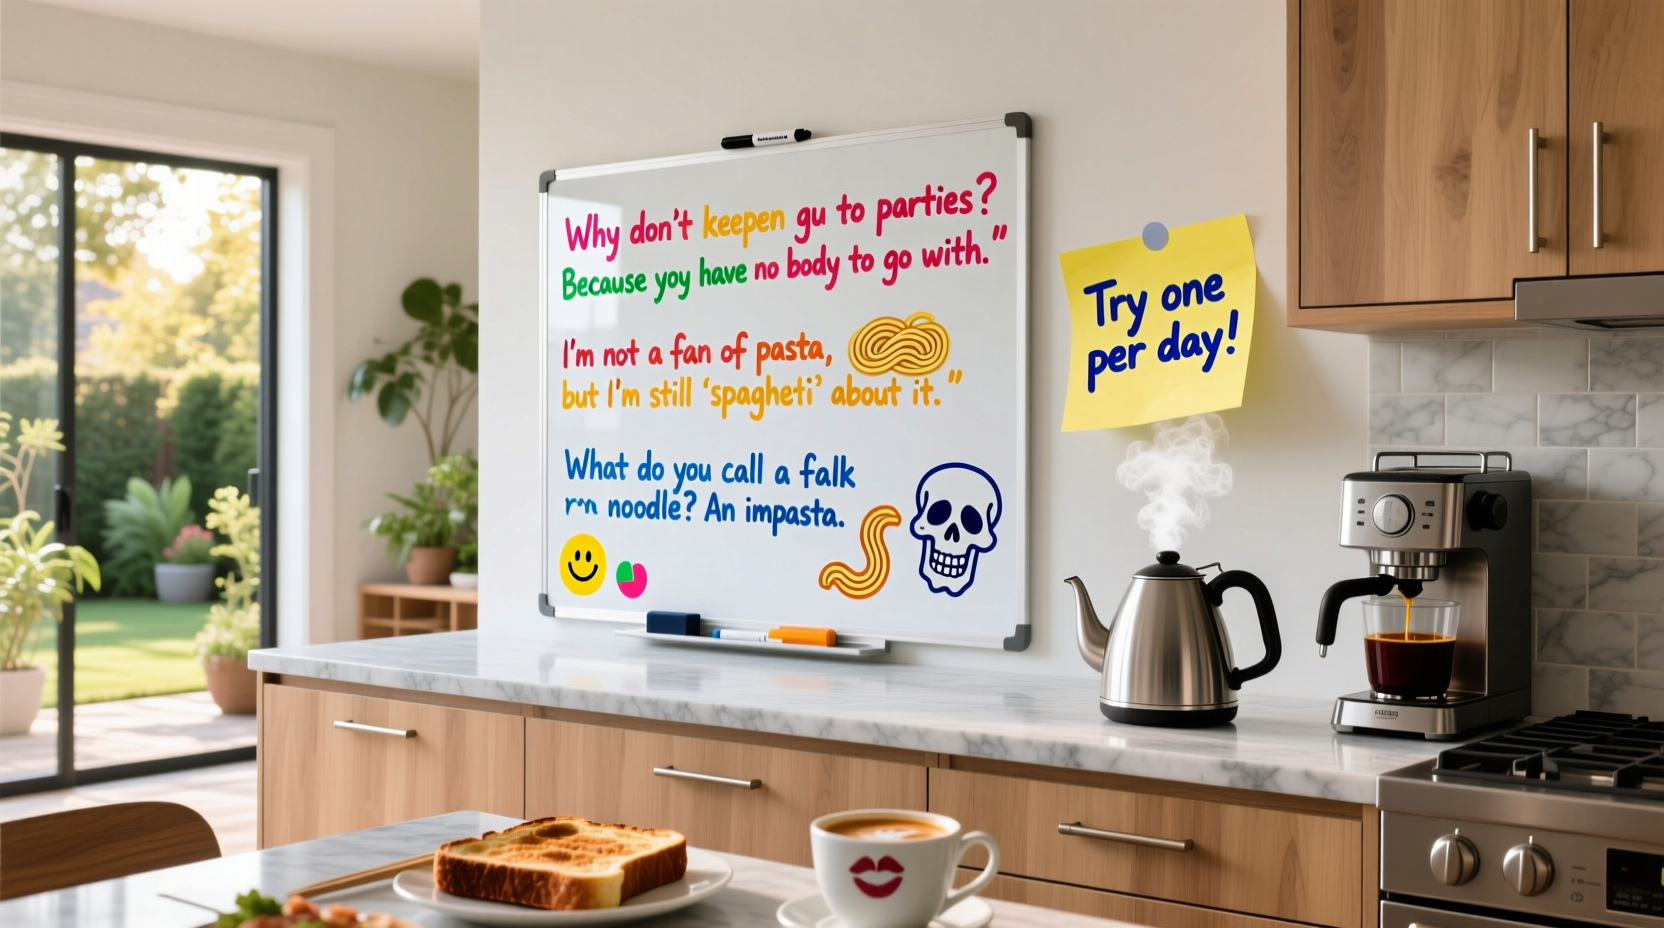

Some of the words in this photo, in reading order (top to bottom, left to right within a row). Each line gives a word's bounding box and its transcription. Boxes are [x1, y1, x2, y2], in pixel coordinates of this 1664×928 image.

[566, 214, 620, 262] Why
[630, 208, 693, 244] don't
[703, 205, 785, 248] keepen
[794, 207, 826, 244] gu
[836, 194, 865, 225] to
[876, 172, 998, 238] parties?
[562, 267, 647, 300] Because
[700, 257, 747, 286] have
[755, 262, 779, 280] no
[787, 242, 840, 290] body
[848, 245, 874, 273] to
[882, 250, 912, 286] go
[1083, 278, 1148, 337] Try
[1161, 273, 1225, 311] one
[563, 338, 594, 368] I'm
[604, 339, 639, 366] not
[649, 346, 662, 364] a
[670, 333, 711, 369] fan
[721, 331, 748, 370] of
[756, 332, 832, 378] pasta,
[1087, 342, 1147, 393] per
[1157, 309, 1239, 373] day!
[562, 380, 599, 410] but
[608, 379, 640, 407] I'm
[650, 377, 692, 408] still
[831, 371, 904, 407] about
[565, 448, 629, 480] What
[637, 450, 664, 481] do
[673, 463, 711, 494] you
[722, 453, 763, 484] call
[775, 465, 790, 485] a
[608, 487, 697, 521] noodle?
[704, 492, 735, 522] An
[746, 497, 844, 536] impasta.
